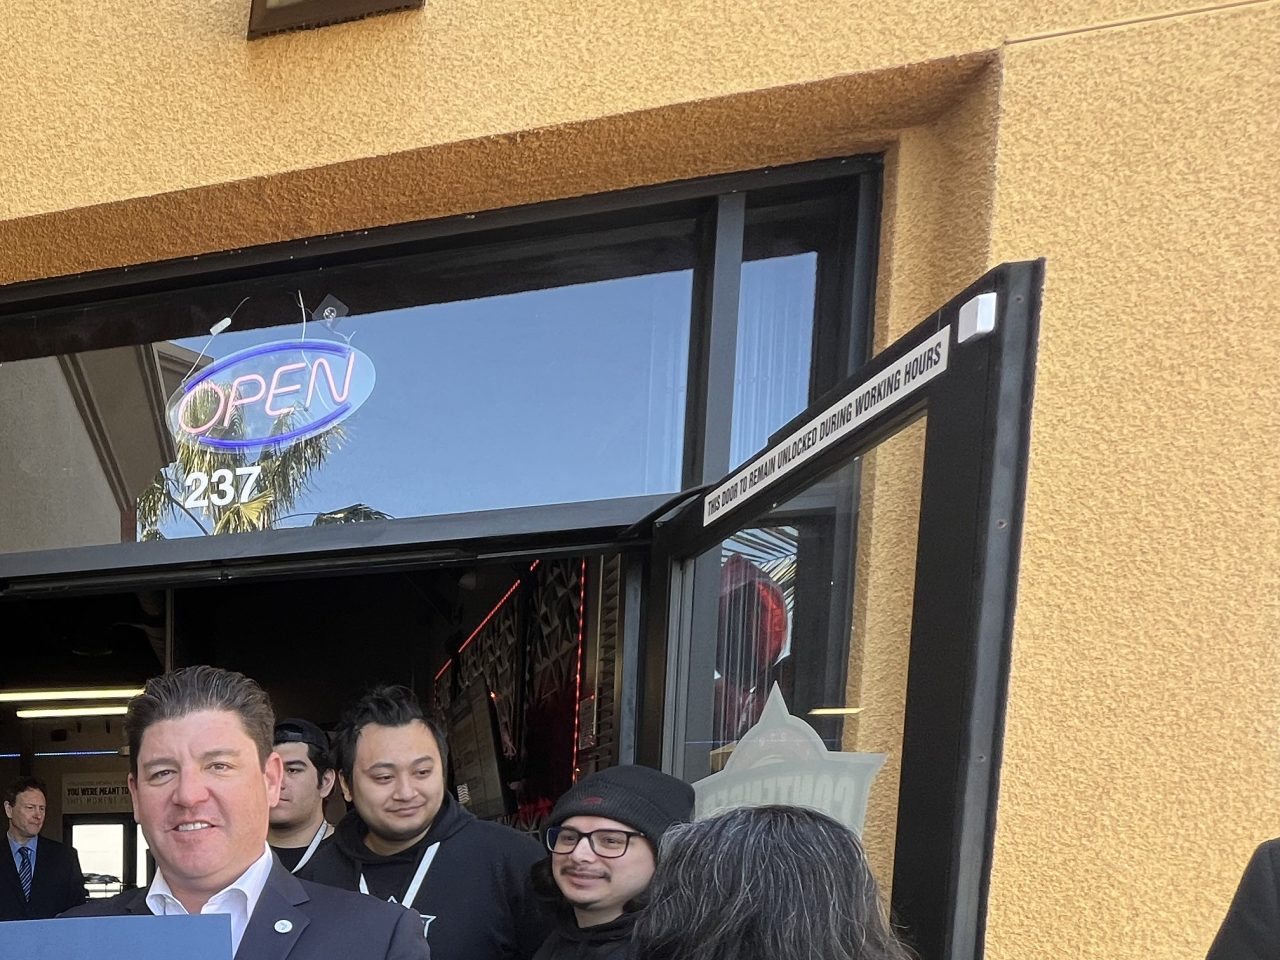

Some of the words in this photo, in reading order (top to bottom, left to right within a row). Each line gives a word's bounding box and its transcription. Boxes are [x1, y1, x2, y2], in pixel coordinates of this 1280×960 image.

[179, 352, 355, 433] OPEN
[708, 500, 721, 516] THIS
[721, 485, 738, 507] DOOR
[738, 476, 748, 495] TO
[748, 456, 776, 490] REMAIN
[777, 431, 817, 469] UNLOCKED
[820, 405, 852, 441] DURING
[855, 369, 901, 418] WORKING
[903, 341, 941, 385] HOURS
[184, 466, 262, 509] 237
[67, 787, 79, 796] YOU
[81, 787, 98, 796] WERE
[99, 786, 120, 796] MEANT
